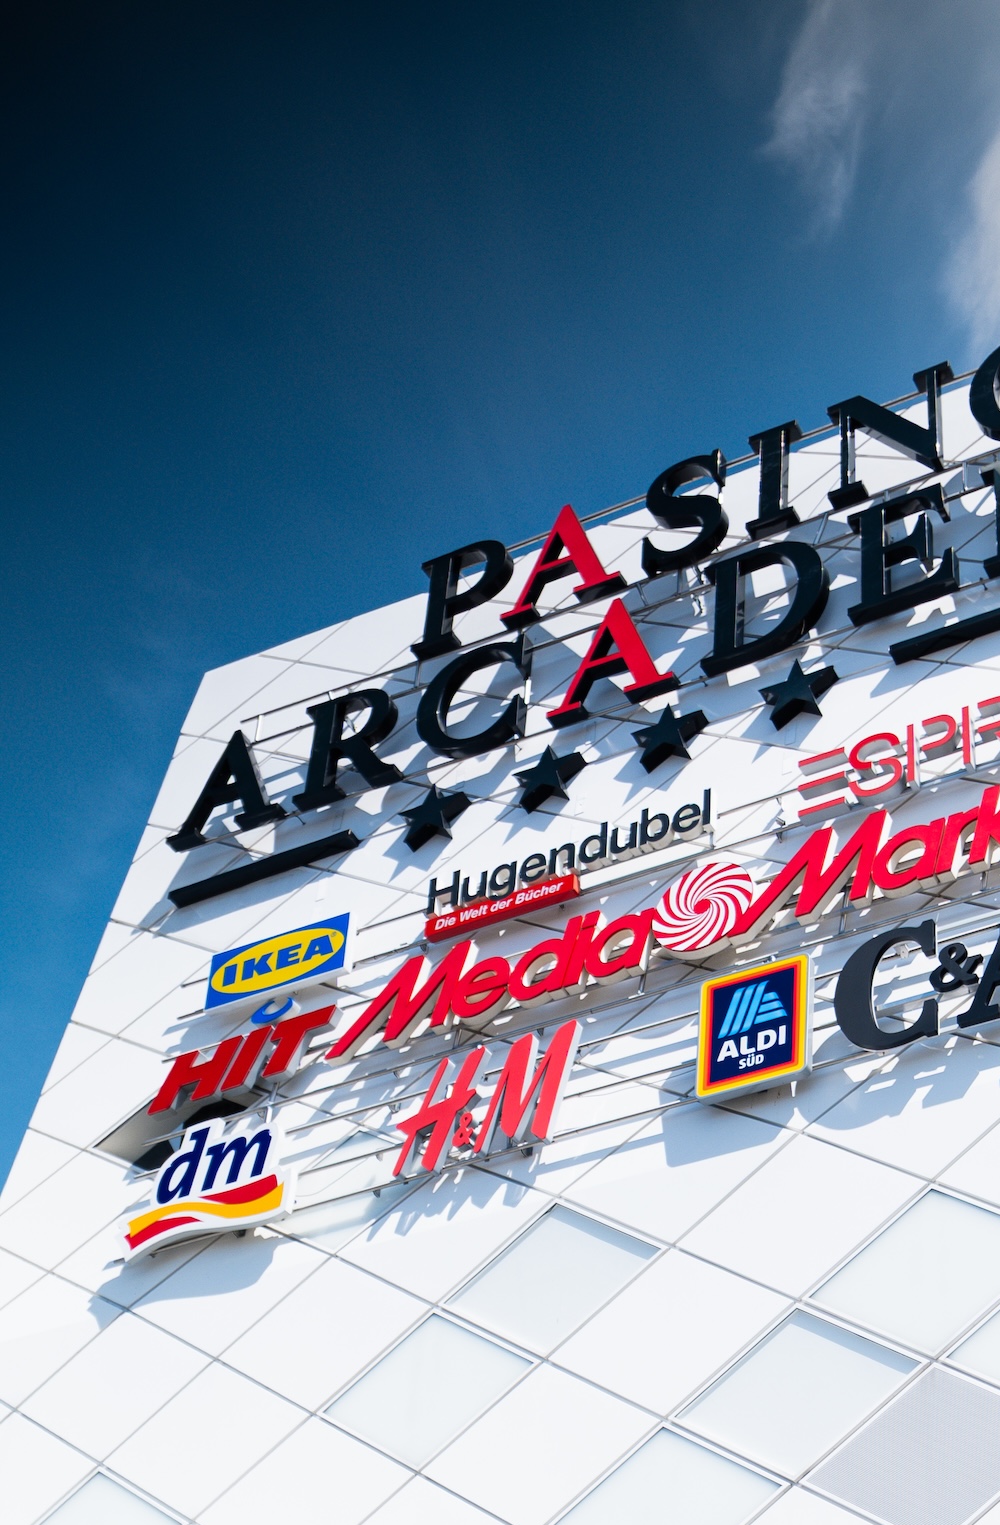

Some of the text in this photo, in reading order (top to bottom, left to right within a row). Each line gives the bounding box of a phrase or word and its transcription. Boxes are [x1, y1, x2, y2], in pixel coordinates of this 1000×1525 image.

[427, 788, 711, 915] Hugendubel
[434, 881, 564, 930] Die Welt der Bücher
[324, 906, 655, 1064] Media
[147, 1004, 338, 1116] HIT
[716, 1027, 787, 1062] ALDI
[738, 1053, 764, 1070] SÜD
[391, 1020, 580, 1177] H&M
[155, 1127, 273, 1204] dm
